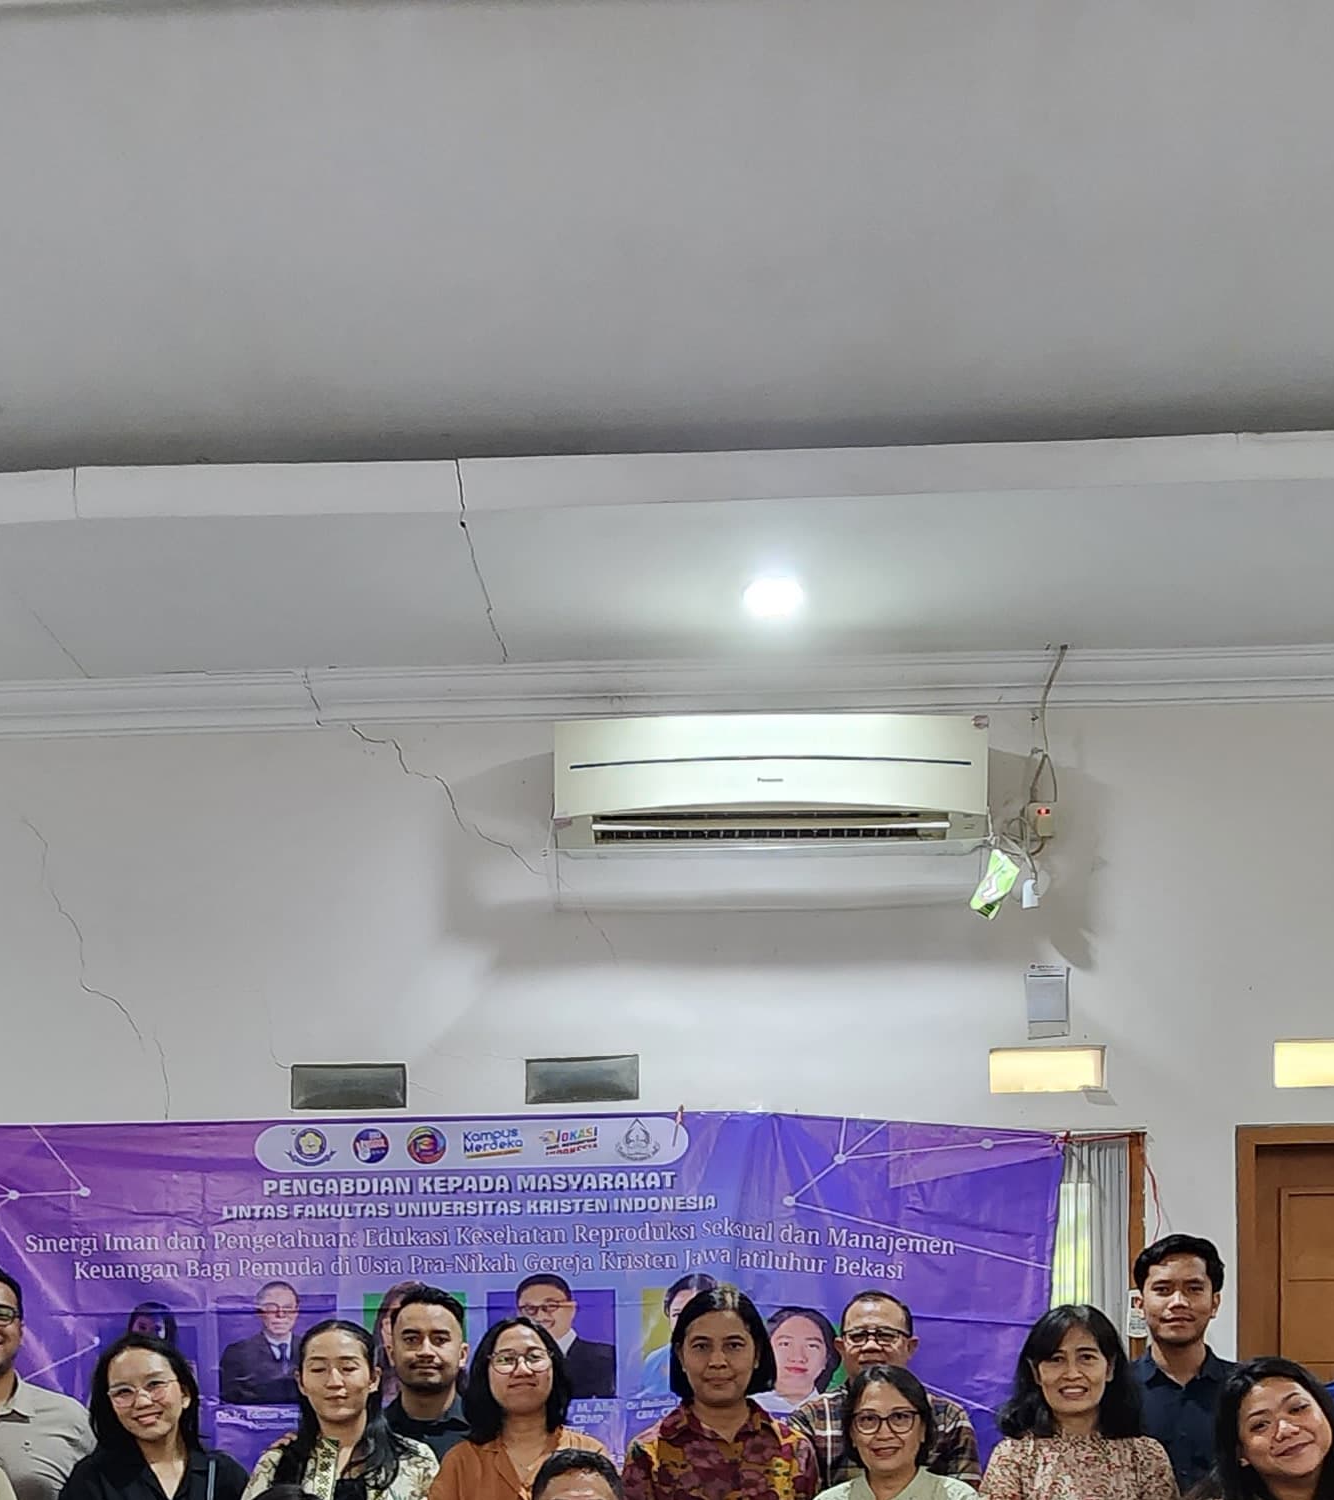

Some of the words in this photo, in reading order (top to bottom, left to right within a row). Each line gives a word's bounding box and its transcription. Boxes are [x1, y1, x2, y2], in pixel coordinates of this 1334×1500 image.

[462, 1127, 519, 1143] Kampus
[463, 1138, 524, 1154] Merdeka
[263, 1177, 411, 1196] PENGABDIAN
[419, 1175, 511, 1194] KEPADA
[517, 1171, 676, 1192] MASYARAKAT
[222, 1203, 288, 1219] LINTAS
[294, 1201, 389, 1219] FAKULTAS
[395, 1199, 521, 1217] UNIVERSITAS
[527, 1197, 608, 1214] KRISTEN
[614, 1194, 717, 1212] INDONESIA
[25, 1233, 98, 1255] Sinergi
[105, 1233, 159, 1250] Iman
[167, 1231, 206, 1250] dan
[214, 1227, 358, 1253] Pengetahuan:
[364, 1227, 449, 1247] Edukasi
[456, 1224, 566, 1245] Kesehatan
[573, 1220, 696, 1247] Reproduksi
[779, 1224, 820, 1245] dan
[827, 1227, 956, 1255] Manajemen
[74, 1261, 179, 1283] Keuangan
[186, 1259, 230, 1282] Bagi
[239, 1257, 324, 1277] Pemuda
[330, 1255, 350, 1275] di
[357, 1255, 402, 1274] Usia
[410, 1252, 516, 1274] Pra-Nikah
[523, 1252, 593, 1275] Gereja
[599, 1250, 677, 1270] Kristen
[683, 1247, 731, 1272] Jawa
[735, 1248, 827, 1273] Jatiluhur
[835, 1256, 904, 1280] Bekasi
